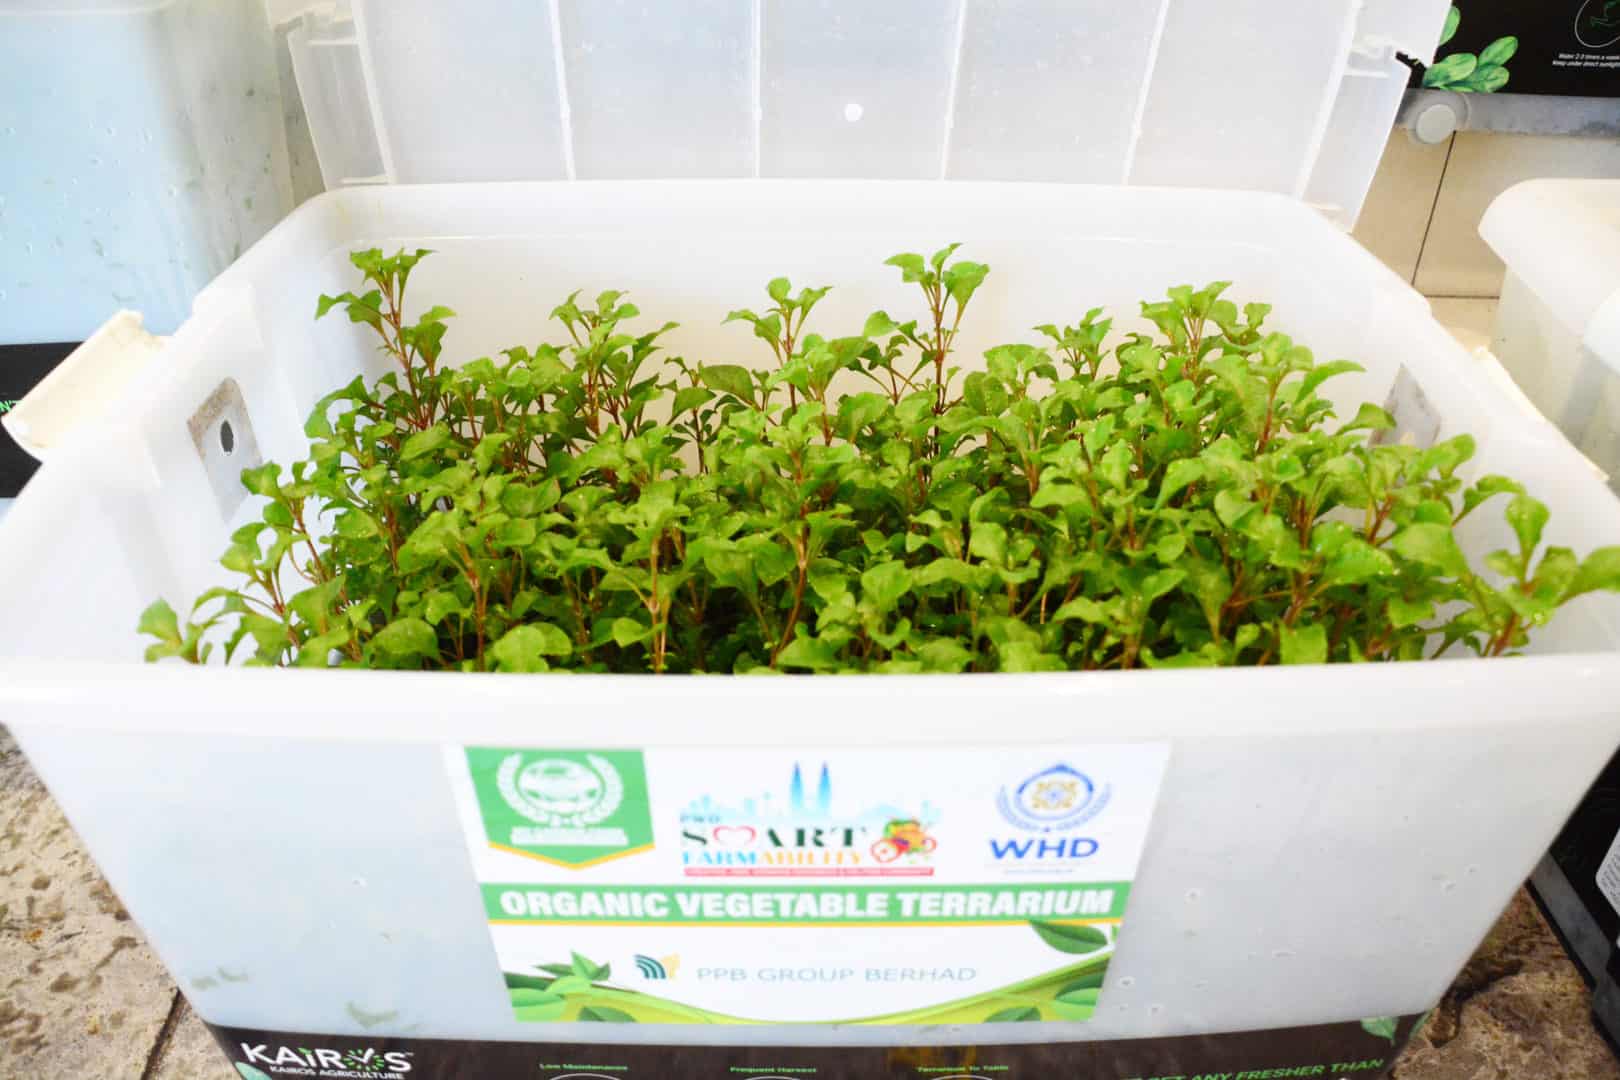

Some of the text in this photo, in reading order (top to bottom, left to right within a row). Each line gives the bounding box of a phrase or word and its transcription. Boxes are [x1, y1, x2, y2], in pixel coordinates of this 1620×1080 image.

[990, 837, 1099, 859] WHD
[500, 888, 1116, 918] ORGANIC VEGETABLE TERRARIUM
[697, 966, 977, 982] PPB GROUP BERHAD
[1235, 1063, 1326, 1080] FRESHER
[1330, 1057, 1385, 1073] THAN
